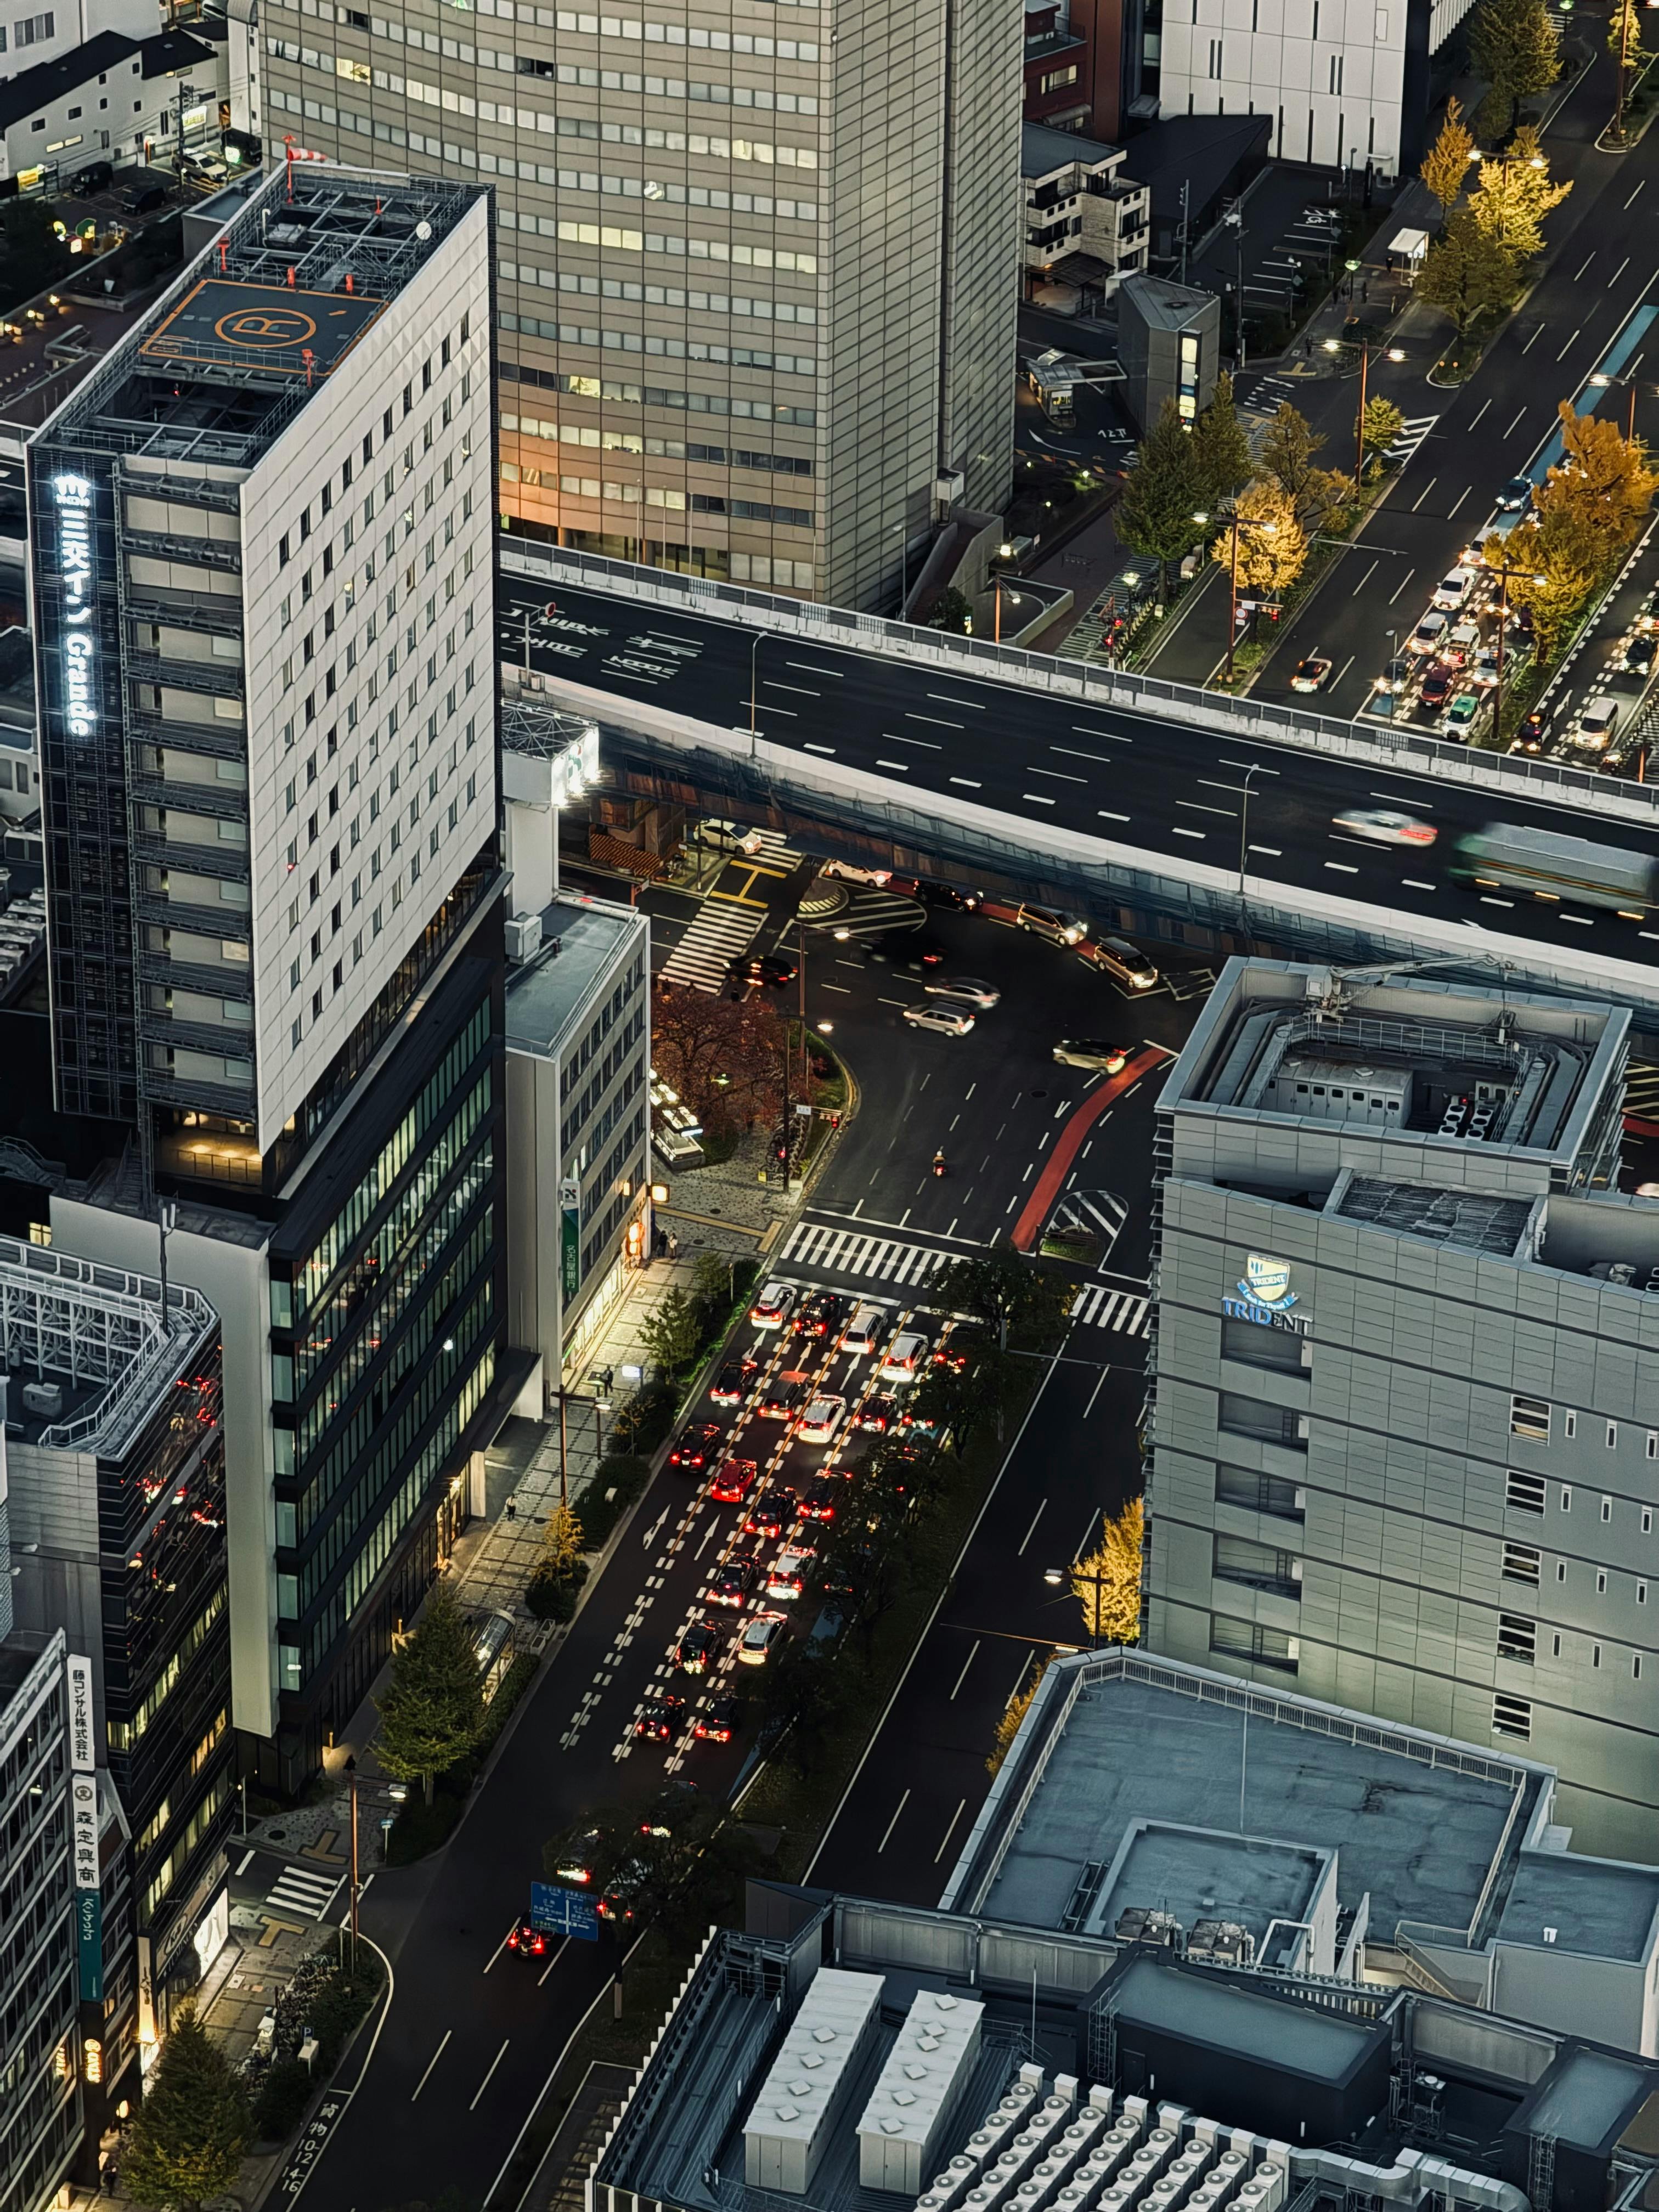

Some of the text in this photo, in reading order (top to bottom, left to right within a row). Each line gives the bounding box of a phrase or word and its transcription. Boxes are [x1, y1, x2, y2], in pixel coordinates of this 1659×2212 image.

[233, 317, 301, 338] R
[62, 509, 91, 623] 三交イン
[67, 633, 96, 735] Grande
[566, 1244, 576, 1288] 名古屋銀行
[1250, 1276, 1285, 1286] TRIDENT
[1221, 1297, 1313, 1335] TRIDENT
[76, 1811, 95, 1883] 森定興商
[82, 1898, 95, 1940] Kubota
[304, 2027, 312, 2036] P
[295, 2151, 313, 2165] 12
[282, 2180, 301, 2193] 16
